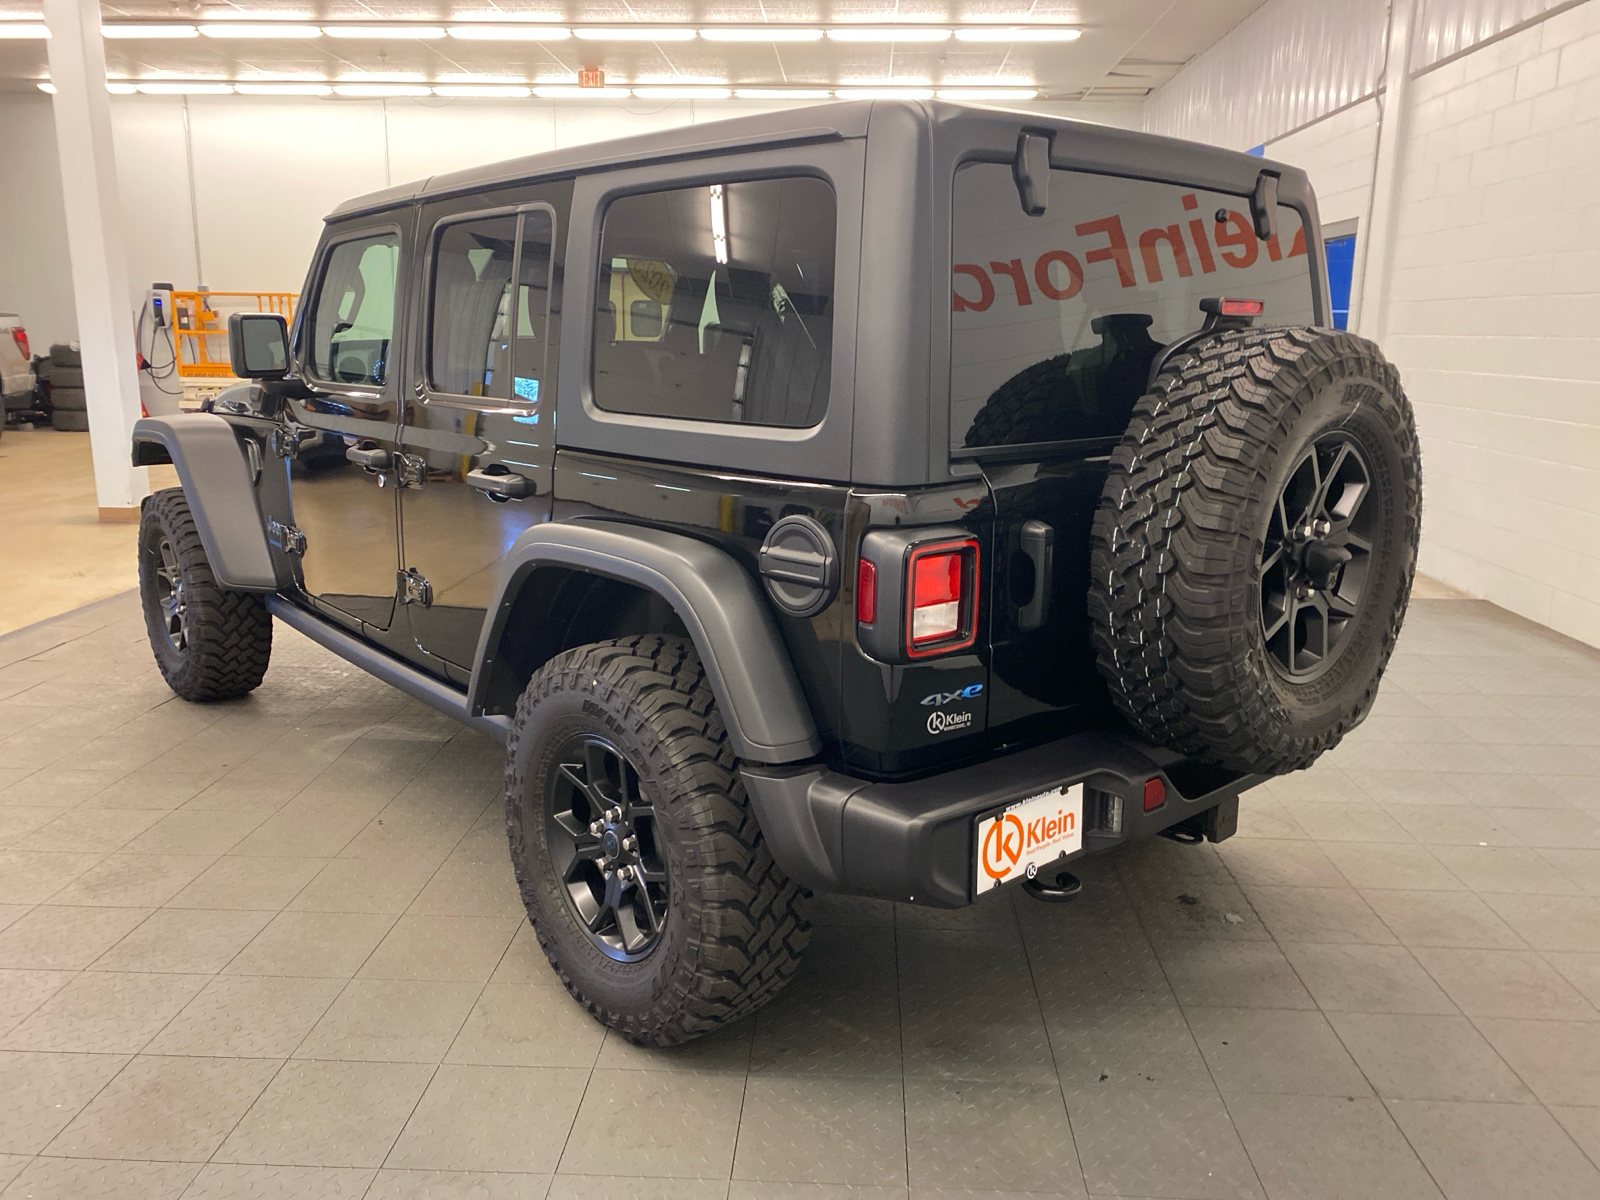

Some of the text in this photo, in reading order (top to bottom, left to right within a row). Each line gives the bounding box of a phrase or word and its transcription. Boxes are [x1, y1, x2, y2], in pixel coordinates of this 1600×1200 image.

[583, 71, 601, 87] EXIT
[946, 711, 972, 726] Klein
[1026, 809, 1075, 848] Klein
